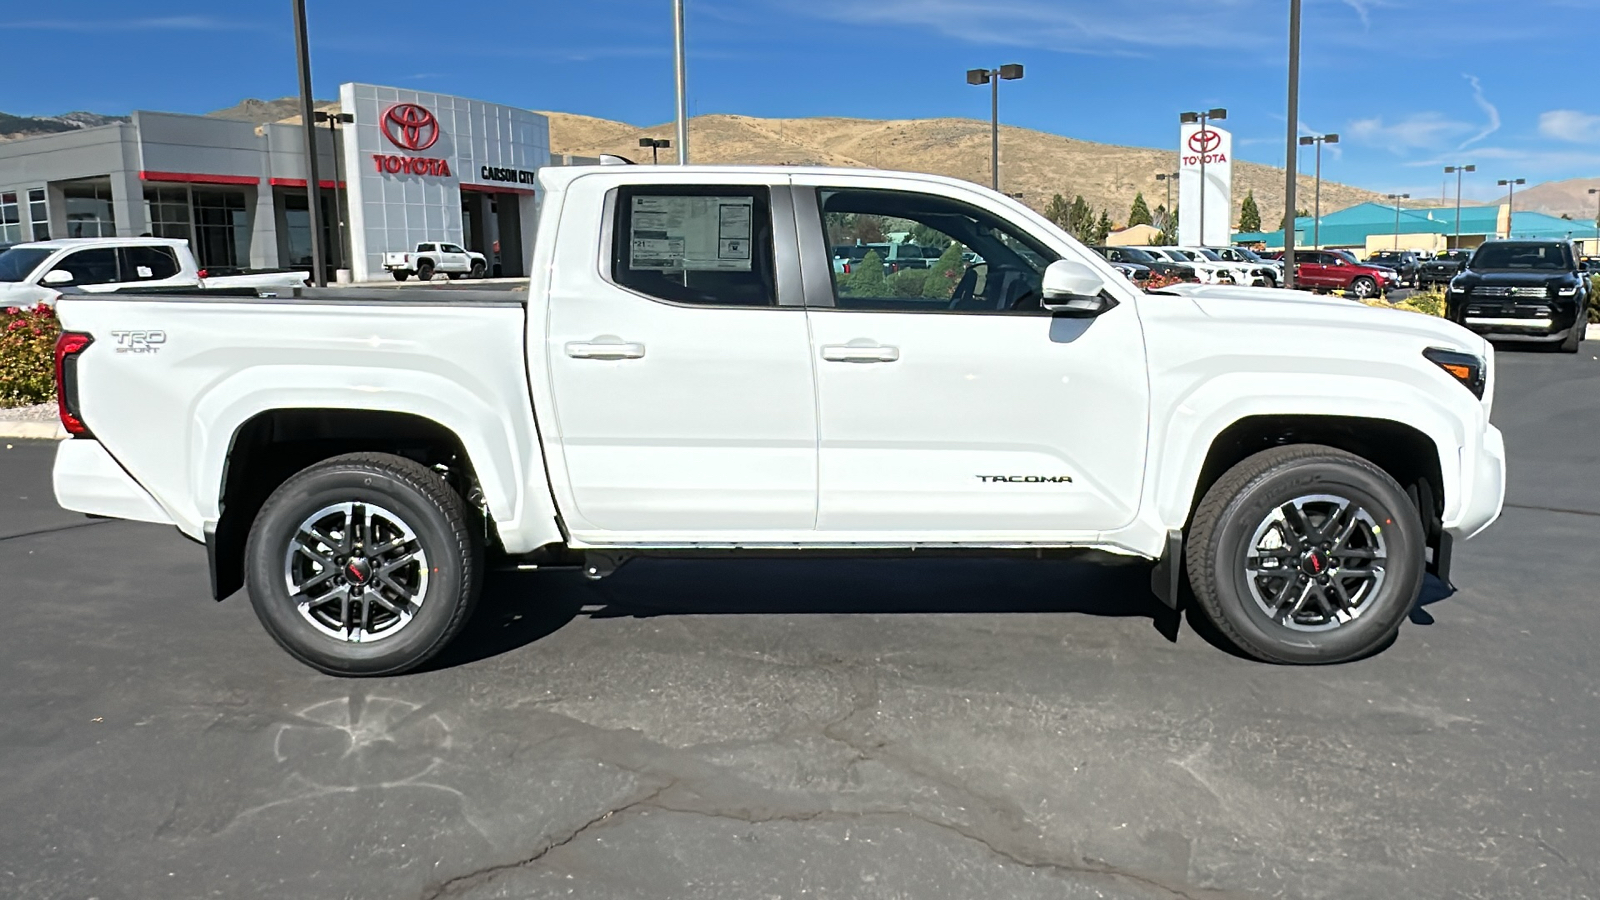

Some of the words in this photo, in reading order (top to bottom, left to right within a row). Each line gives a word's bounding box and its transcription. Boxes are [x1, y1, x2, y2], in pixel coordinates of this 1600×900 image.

[373, 154, 451, 177] TOYOTA
[481, 165, 517, 183] CARSON
[518, 170, 534, 185] CITY
[111, 330, 167, 348] TRD
[975, 475, 1073, 483] TACOMA
